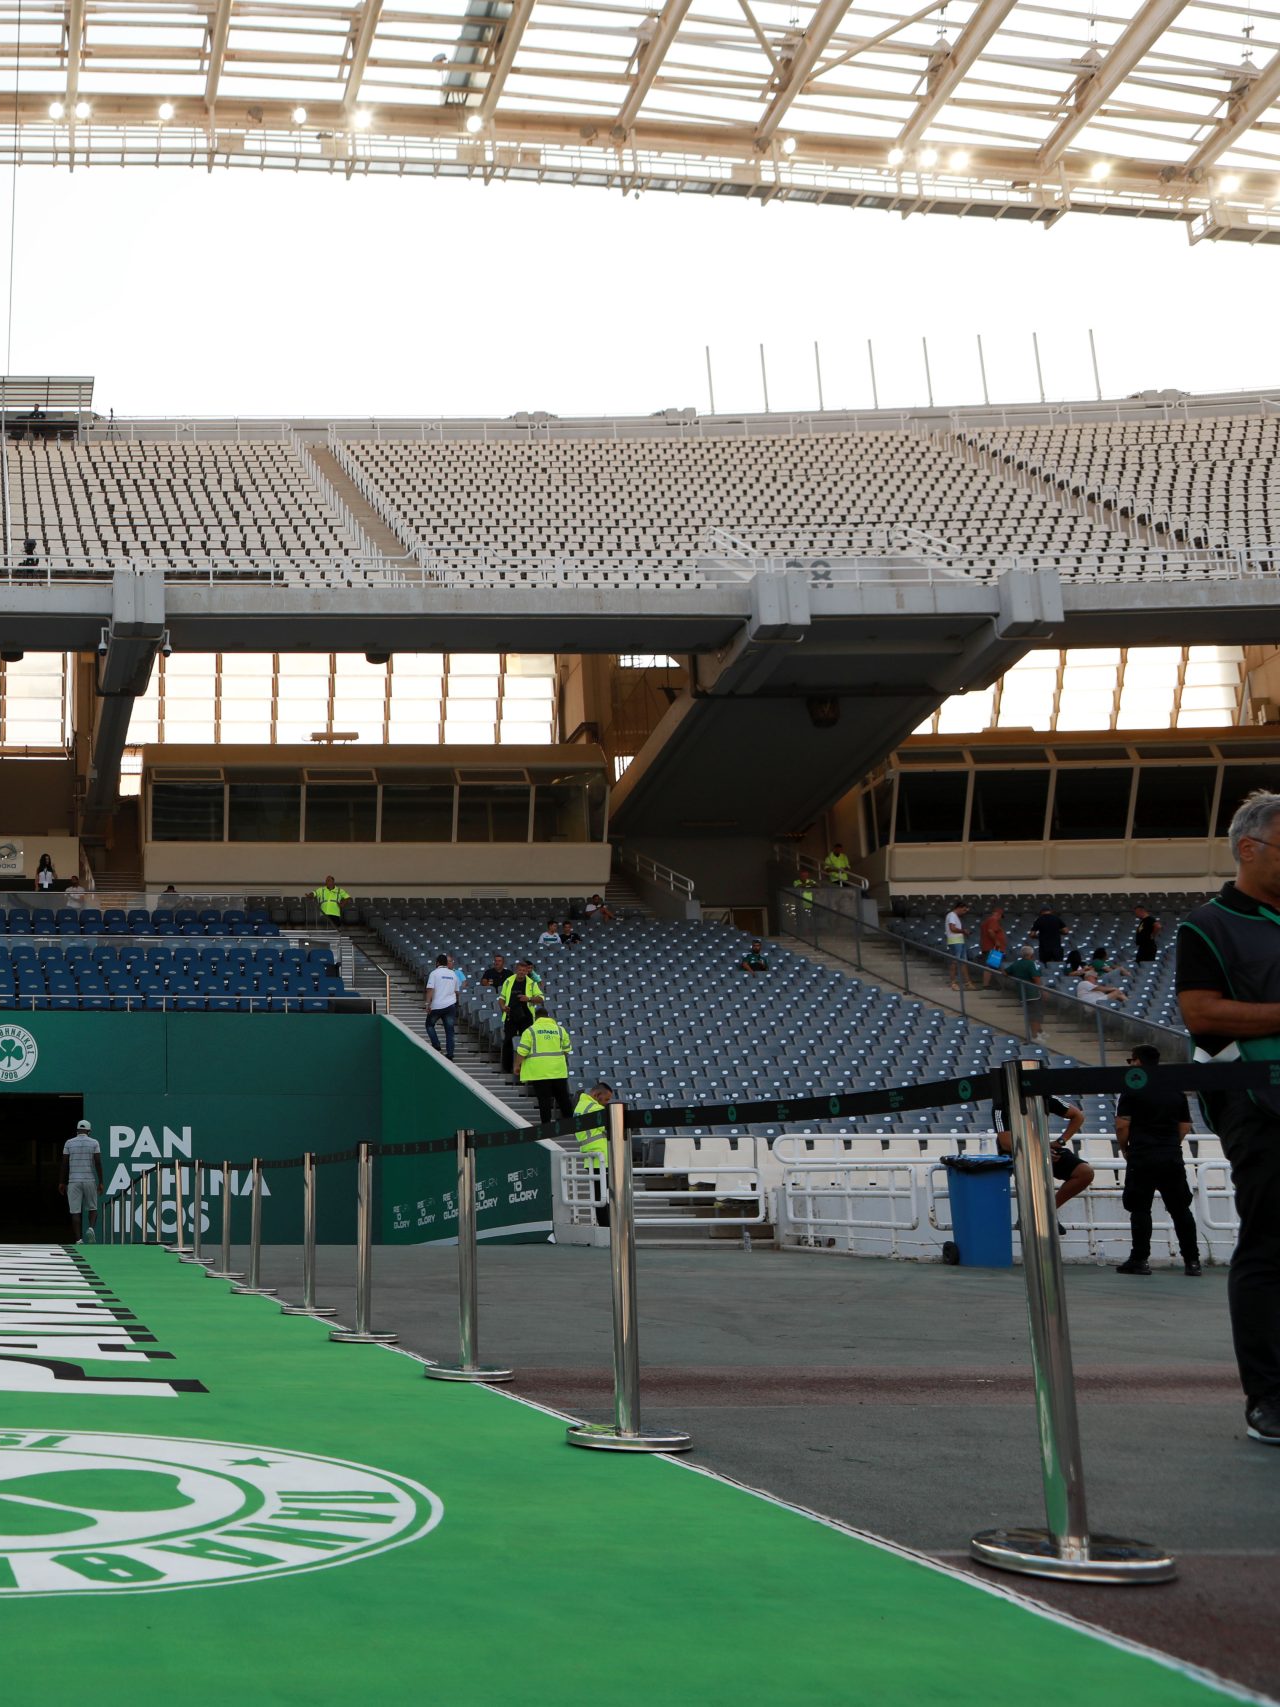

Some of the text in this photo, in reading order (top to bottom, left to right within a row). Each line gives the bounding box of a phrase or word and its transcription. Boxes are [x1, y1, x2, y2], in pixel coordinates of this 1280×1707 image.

[0, 1071, 19, 1080] 1908
[109, 1125, 192, 1158] PAN
[105, 1163, 272, 1196] ATHNA
[507, 1168, 538, 1183] RETURN
[508, 1189, 539, 1204] GLORY
[417, 1214, 436, 1227] GLORY
[443, 1208, 459, 1221] GLOR
